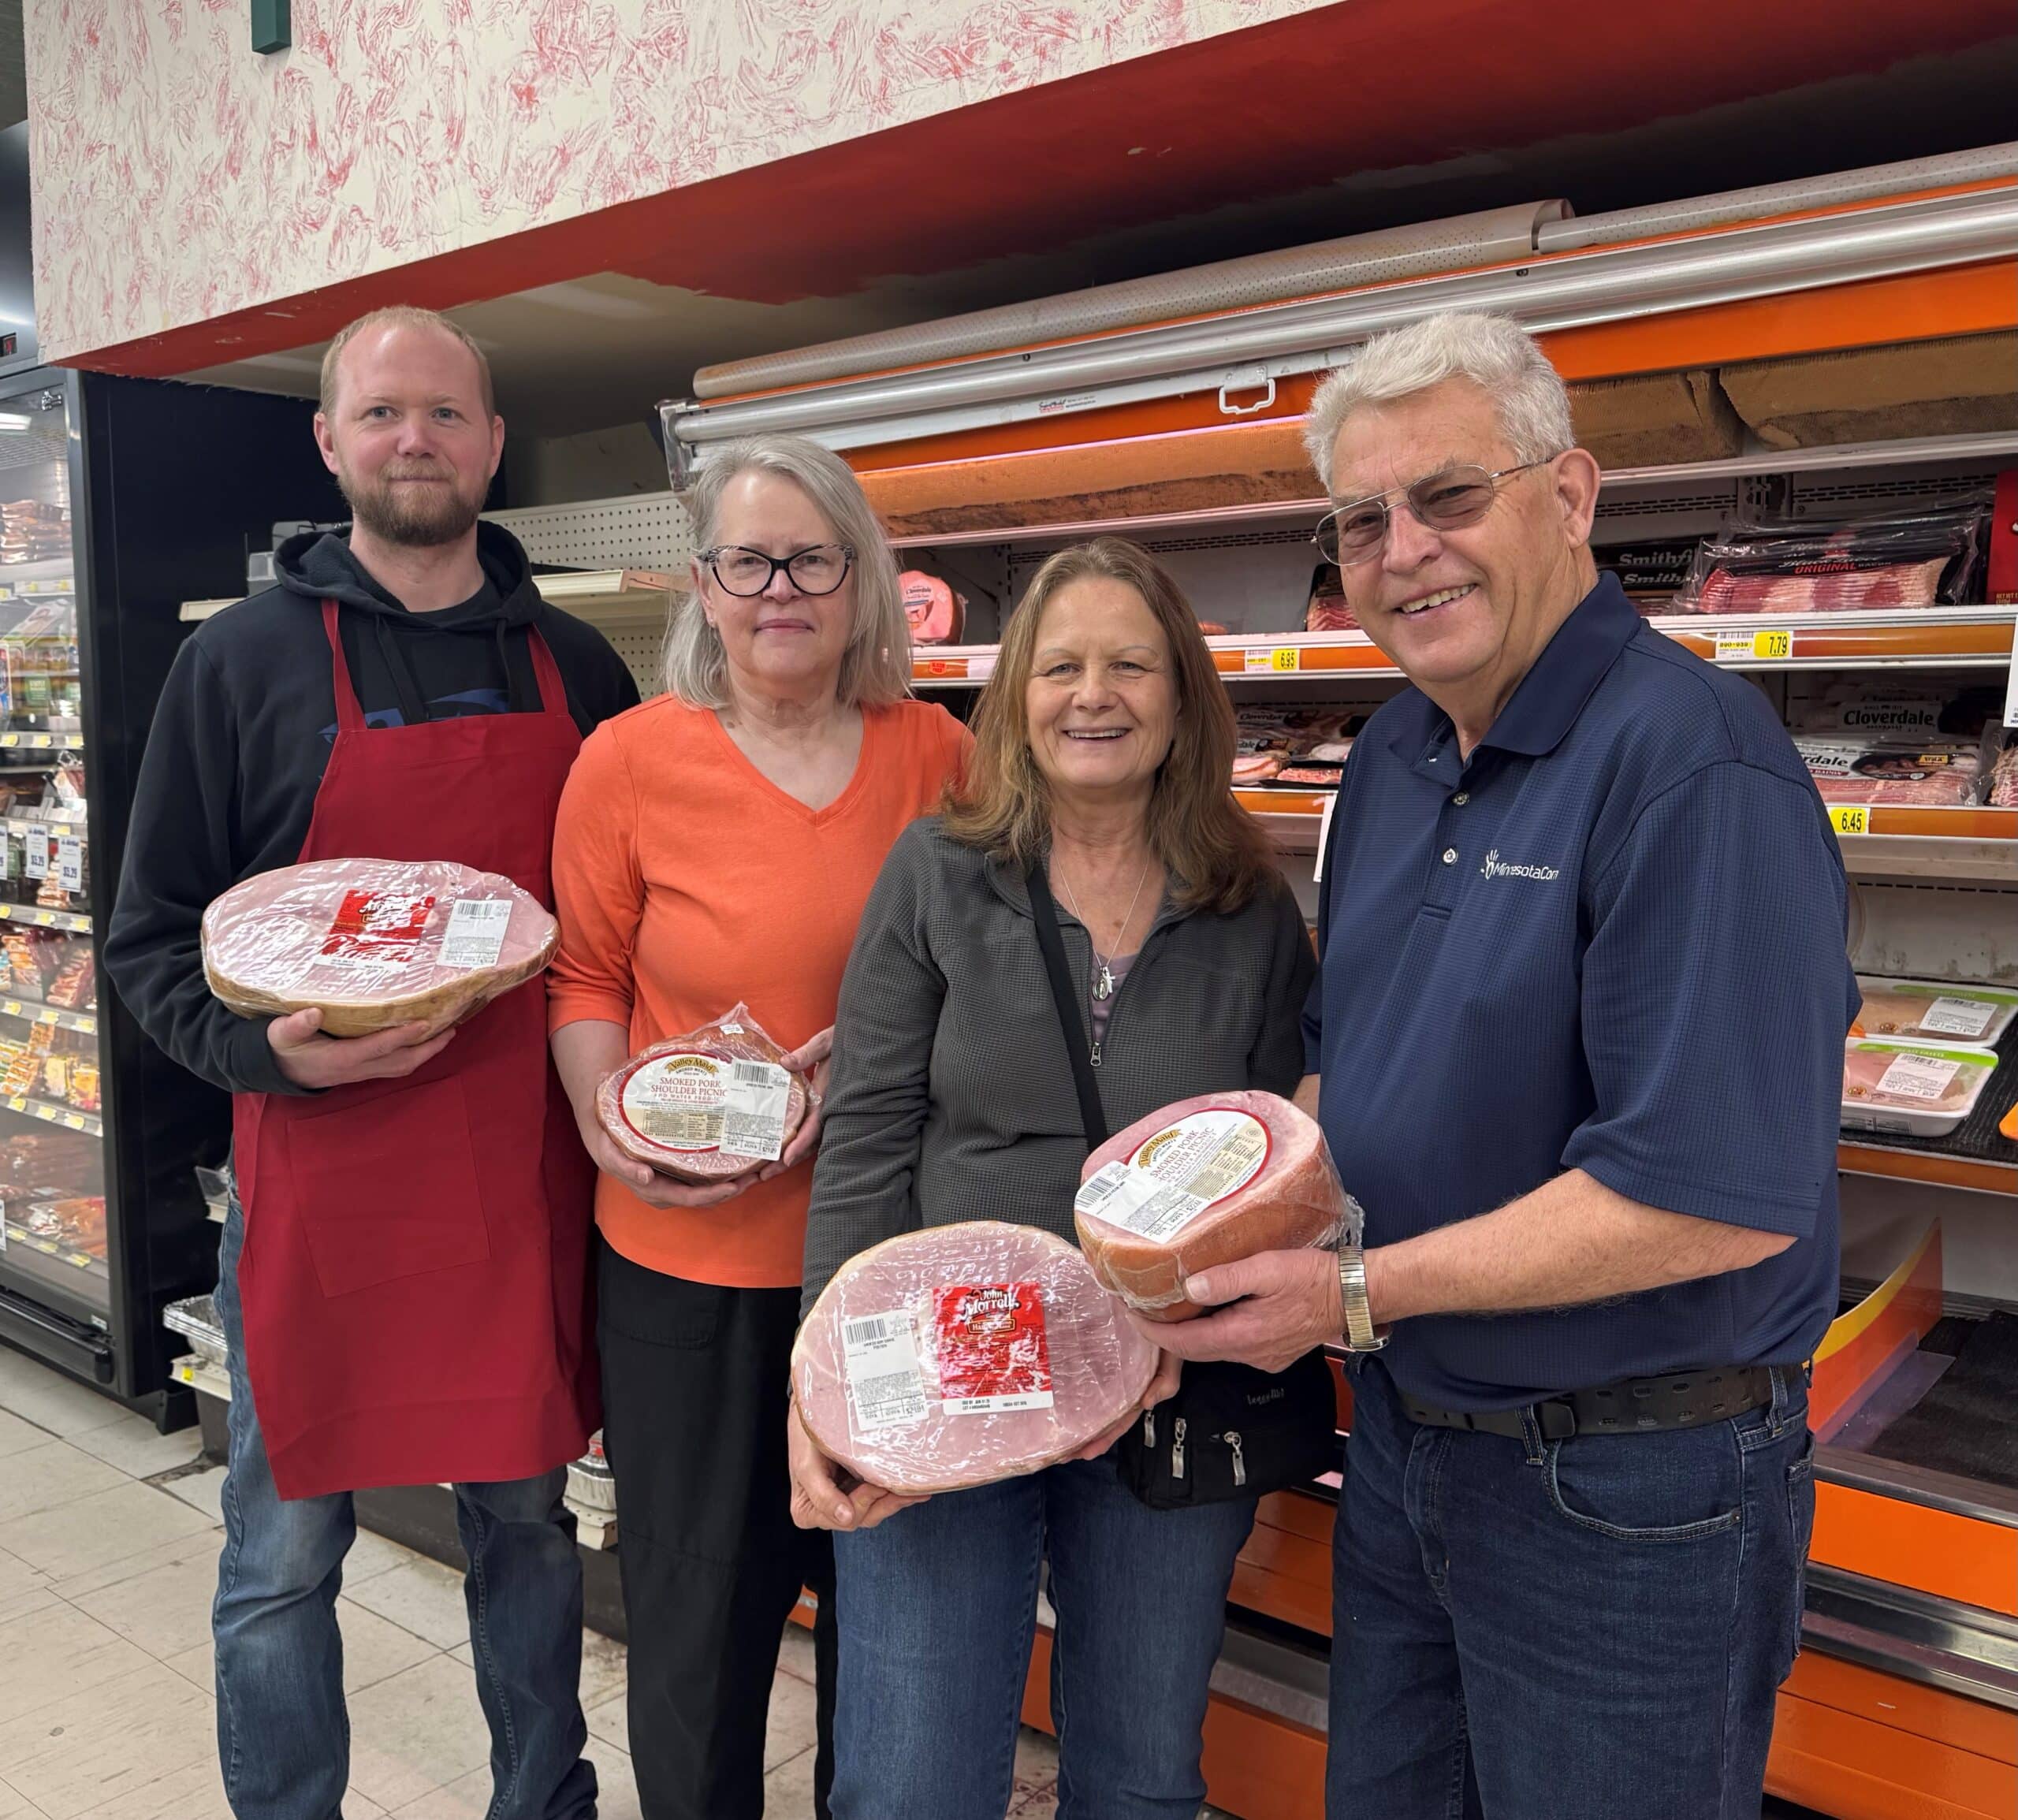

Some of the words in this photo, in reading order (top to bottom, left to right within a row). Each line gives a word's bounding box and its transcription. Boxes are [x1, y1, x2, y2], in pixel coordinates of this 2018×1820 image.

[1619, 549, 1693, 567] Smithfi
[1794, 562, 1856, 574] ORIGINAL
[1769, 636, 1788, 654] 7.79
[1280, 652, 1295, 668] 6.95
[1843, 710, 1936, 727] Cloverdale
[1803, 755, 1849, 768] rdale
[1841, 812, 1862, 830] 6.45
[670, 1058, 693, 1069] Valley
[694, 1057, 714, 1071] Maid
[650, 1084, 697, 1095] SHOULDER
[660, 1077, 696, 1086] SMOKED
[698, 1079, 721, 1089] PORK
[1188, 1127, 1215, 1152] PICNIC
[1150, 1150, 1181, 1178] SMOKED
[1178, 1130, 1199, 1149] PORK
[980, 1289, 1003, 1301] John
